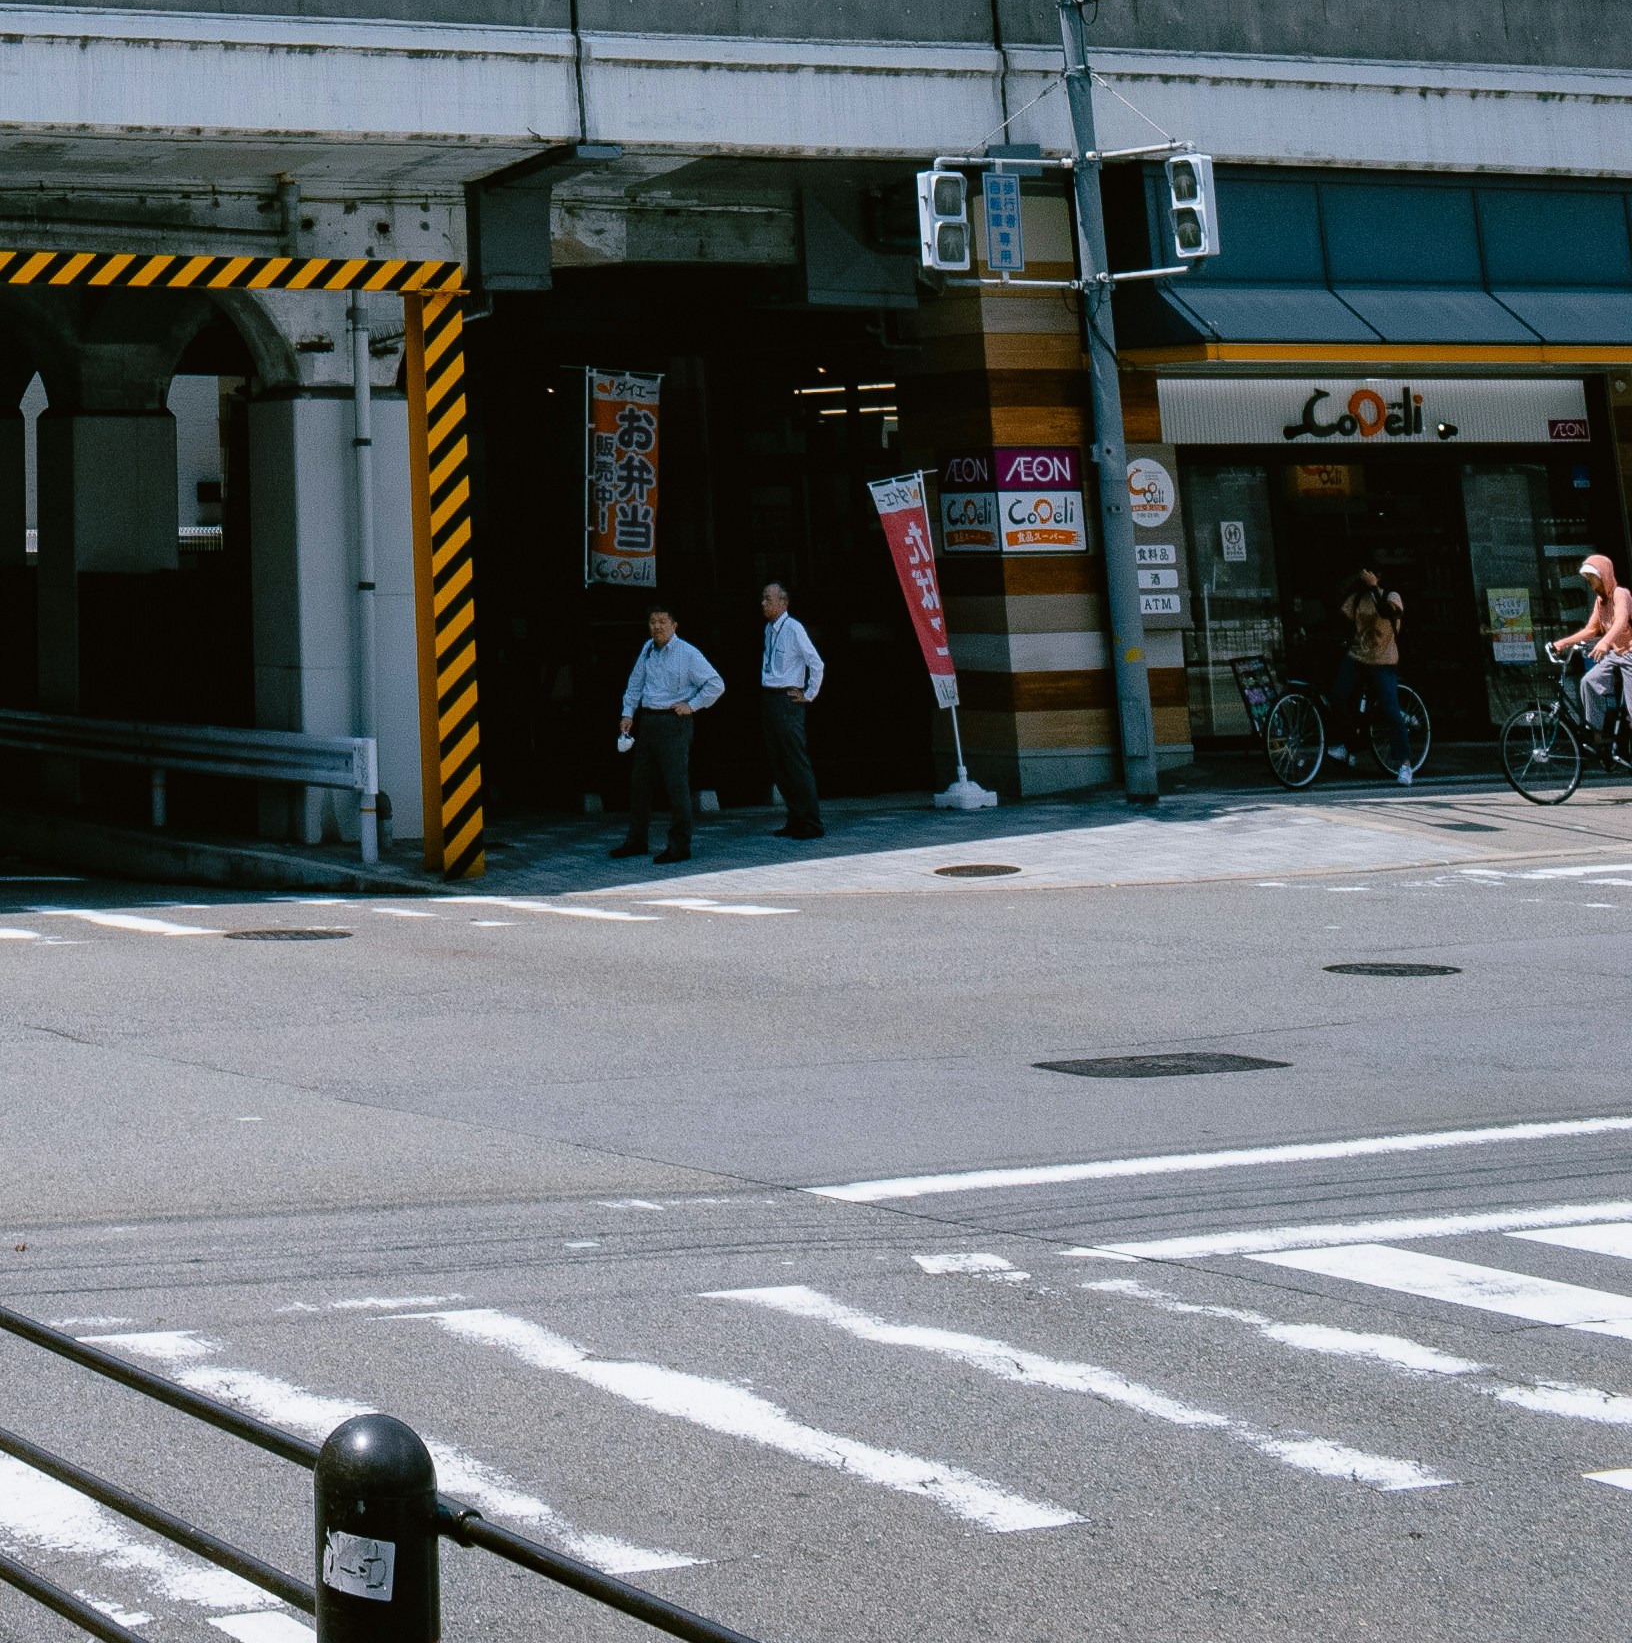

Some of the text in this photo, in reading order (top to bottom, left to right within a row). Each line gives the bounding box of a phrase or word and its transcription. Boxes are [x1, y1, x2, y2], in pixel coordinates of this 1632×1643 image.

[614, 382, 658, 398] ダイエー
[1300, 386, 1424, 438] CoDeli
[615, 404, 655, 551] お弁当
[1008, 496, 1075, 525] CoDeli
[1137, 548, 1169, 560] 食料品
[1150, 572, 1161, 586] 酒
[1144, 598, 1172, 611] ATM
